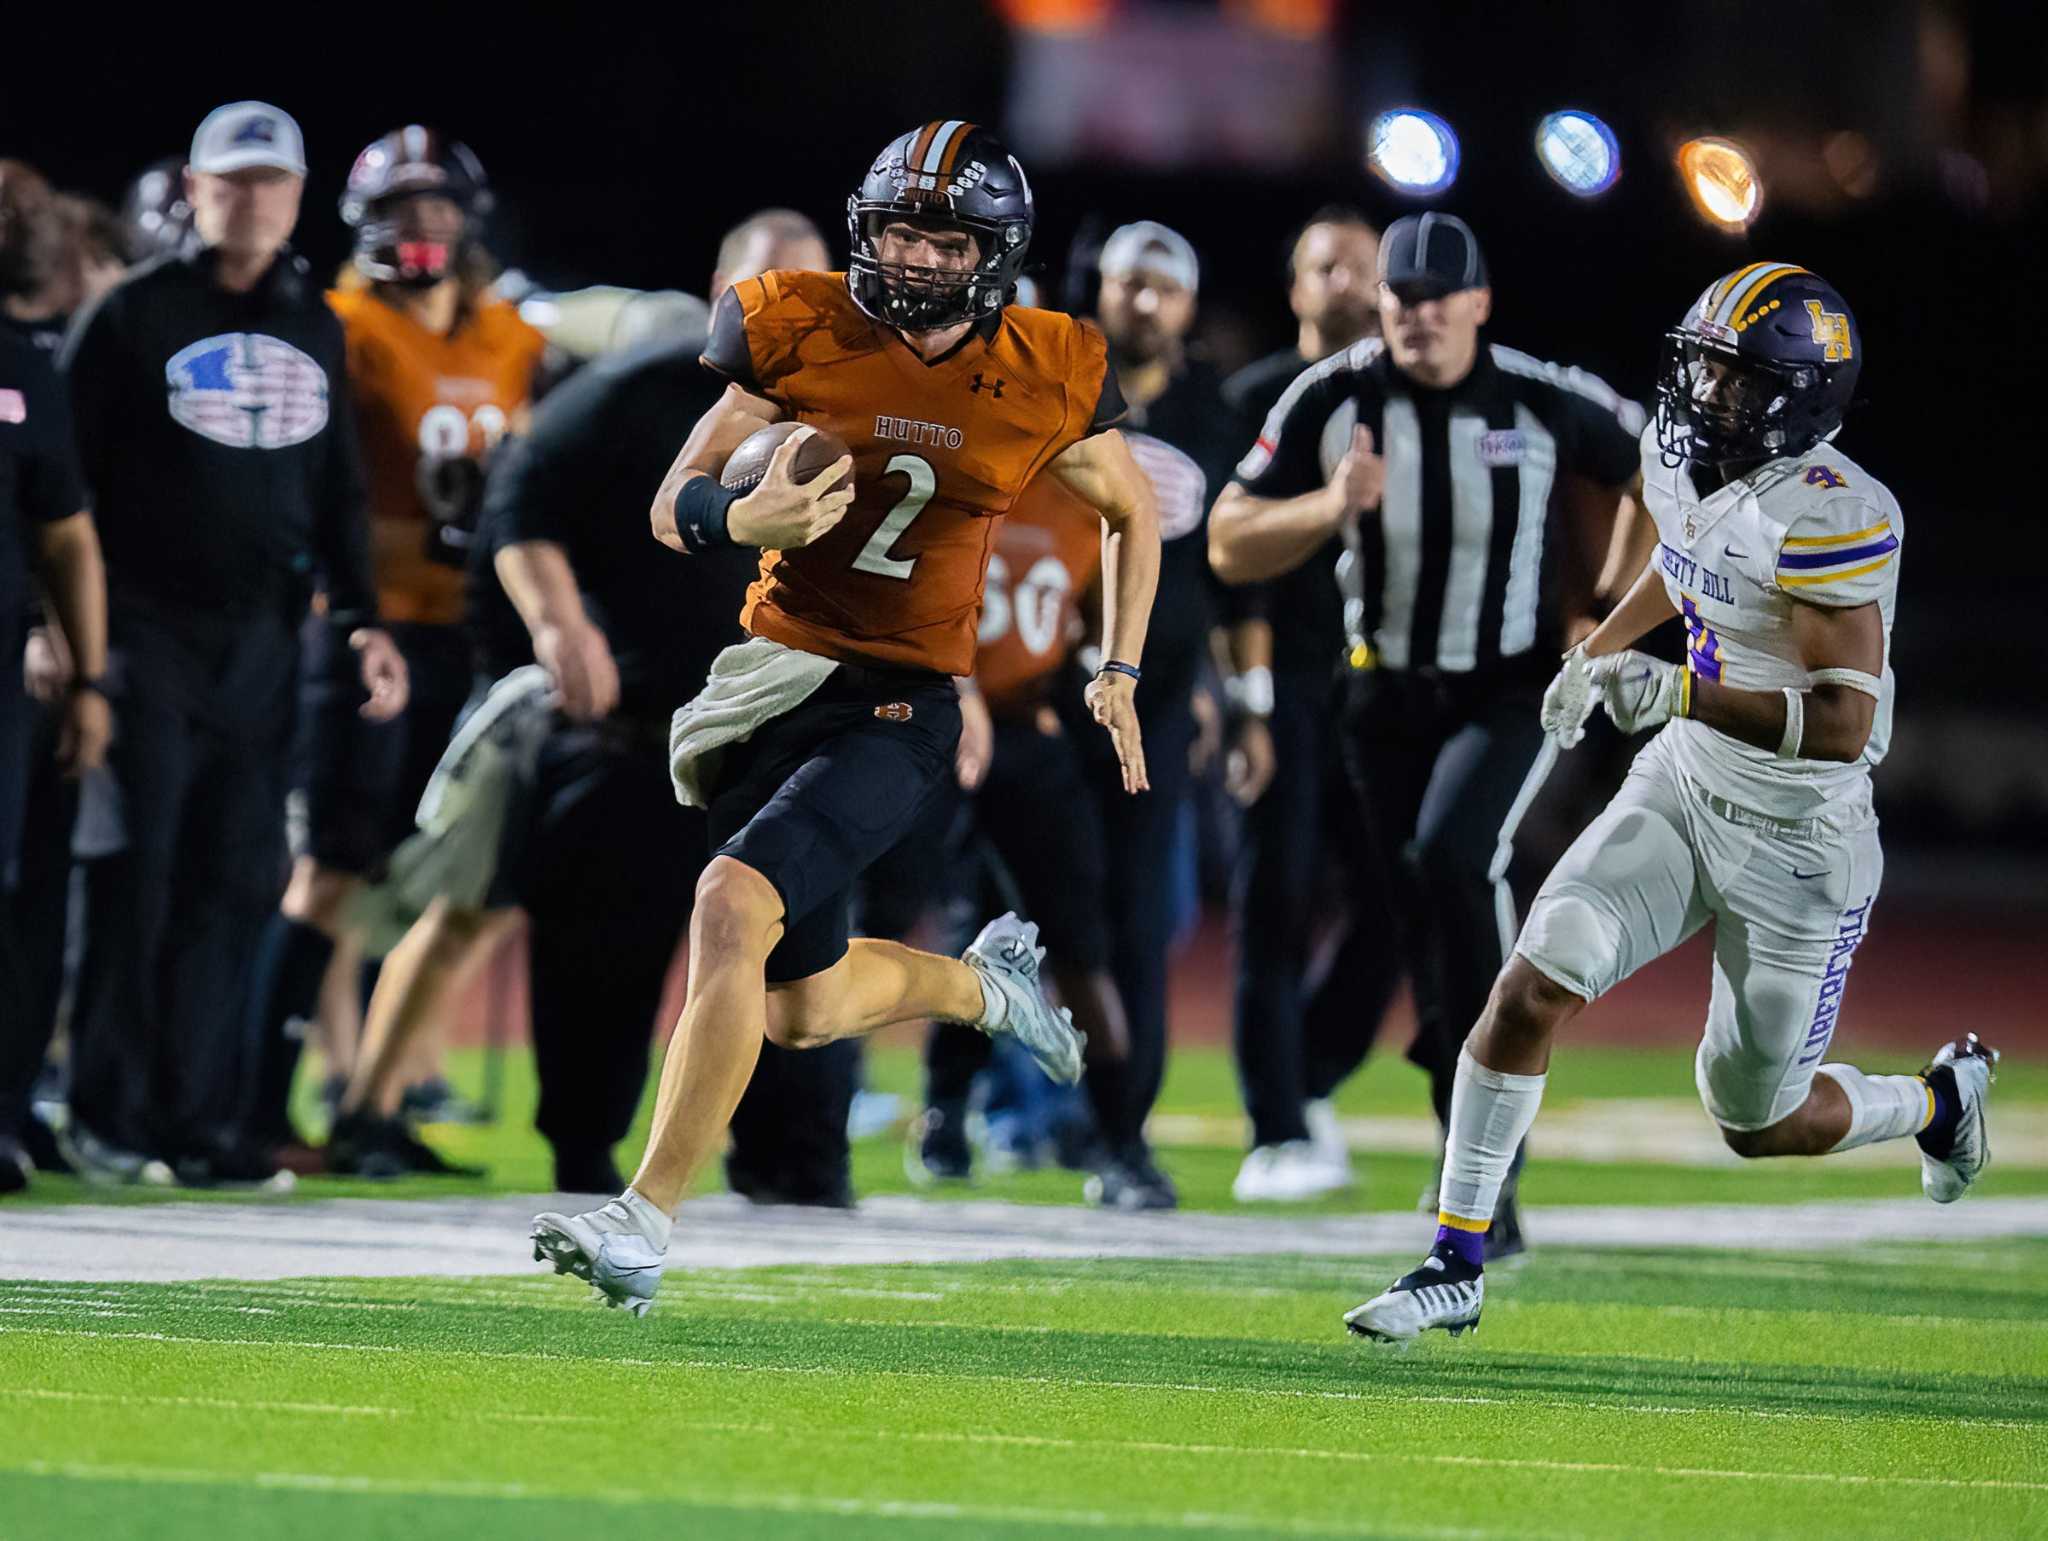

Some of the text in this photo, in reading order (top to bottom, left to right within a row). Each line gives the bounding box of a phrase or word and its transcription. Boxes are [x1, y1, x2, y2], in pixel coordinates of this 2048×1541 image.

[1803, 299, 1852, 362] LH
[874, 415, 963, 449] HUTTO
[852, 454, 936, 580] 2
[1701, 567, 1735, 606] HILL
